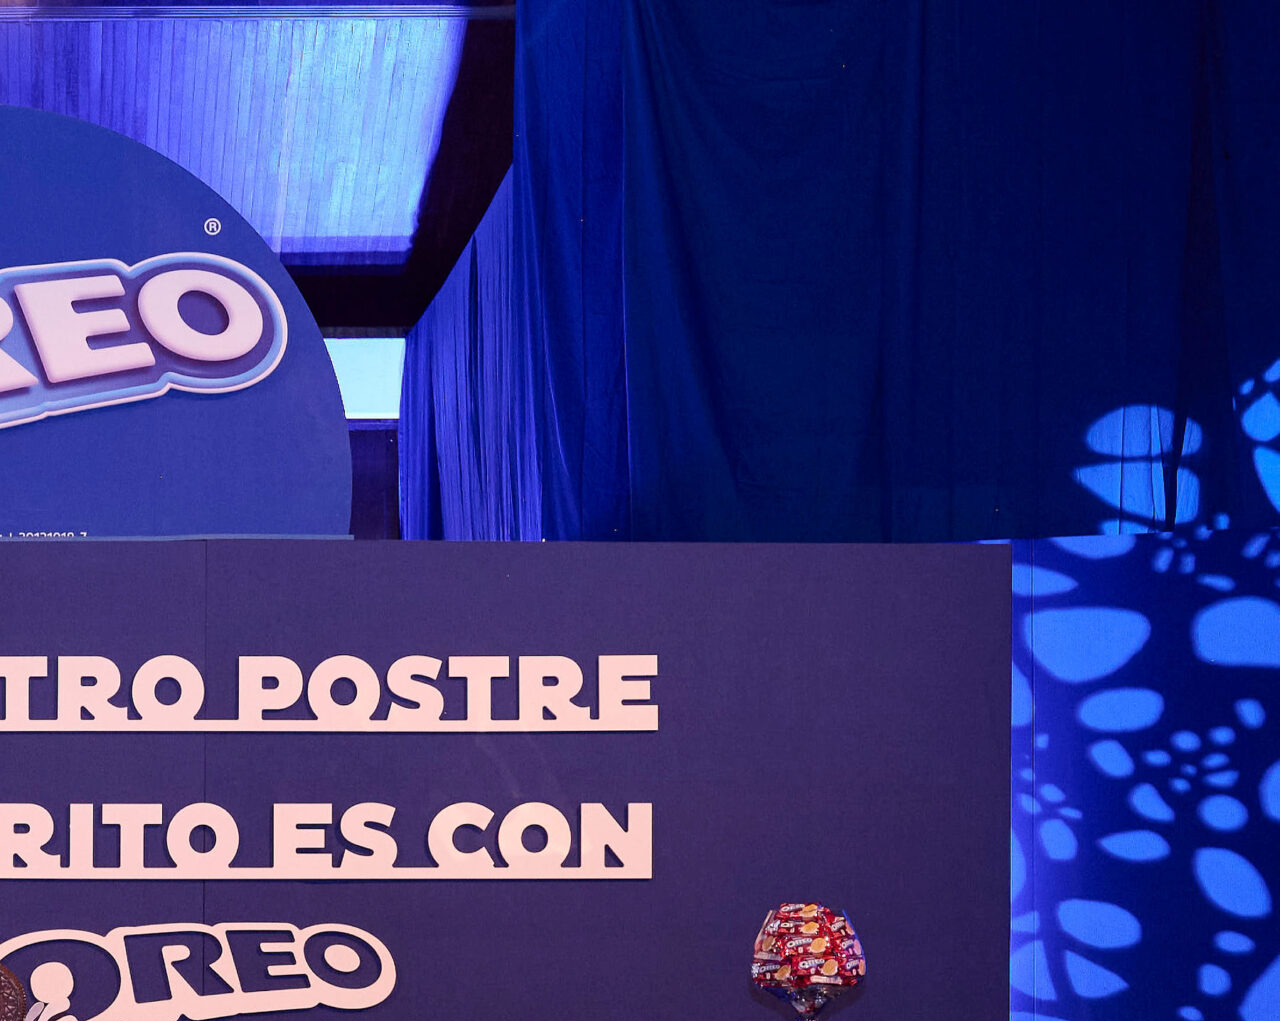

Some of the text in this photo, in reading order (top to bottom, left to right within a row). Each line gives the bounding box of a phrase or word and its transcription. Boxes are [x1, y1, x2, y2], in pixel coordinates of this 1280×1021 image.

[237, 655, 659, 731] POSTRE
[272, 803, 399, 878] ES
[427, 803, 654, 878] CON
